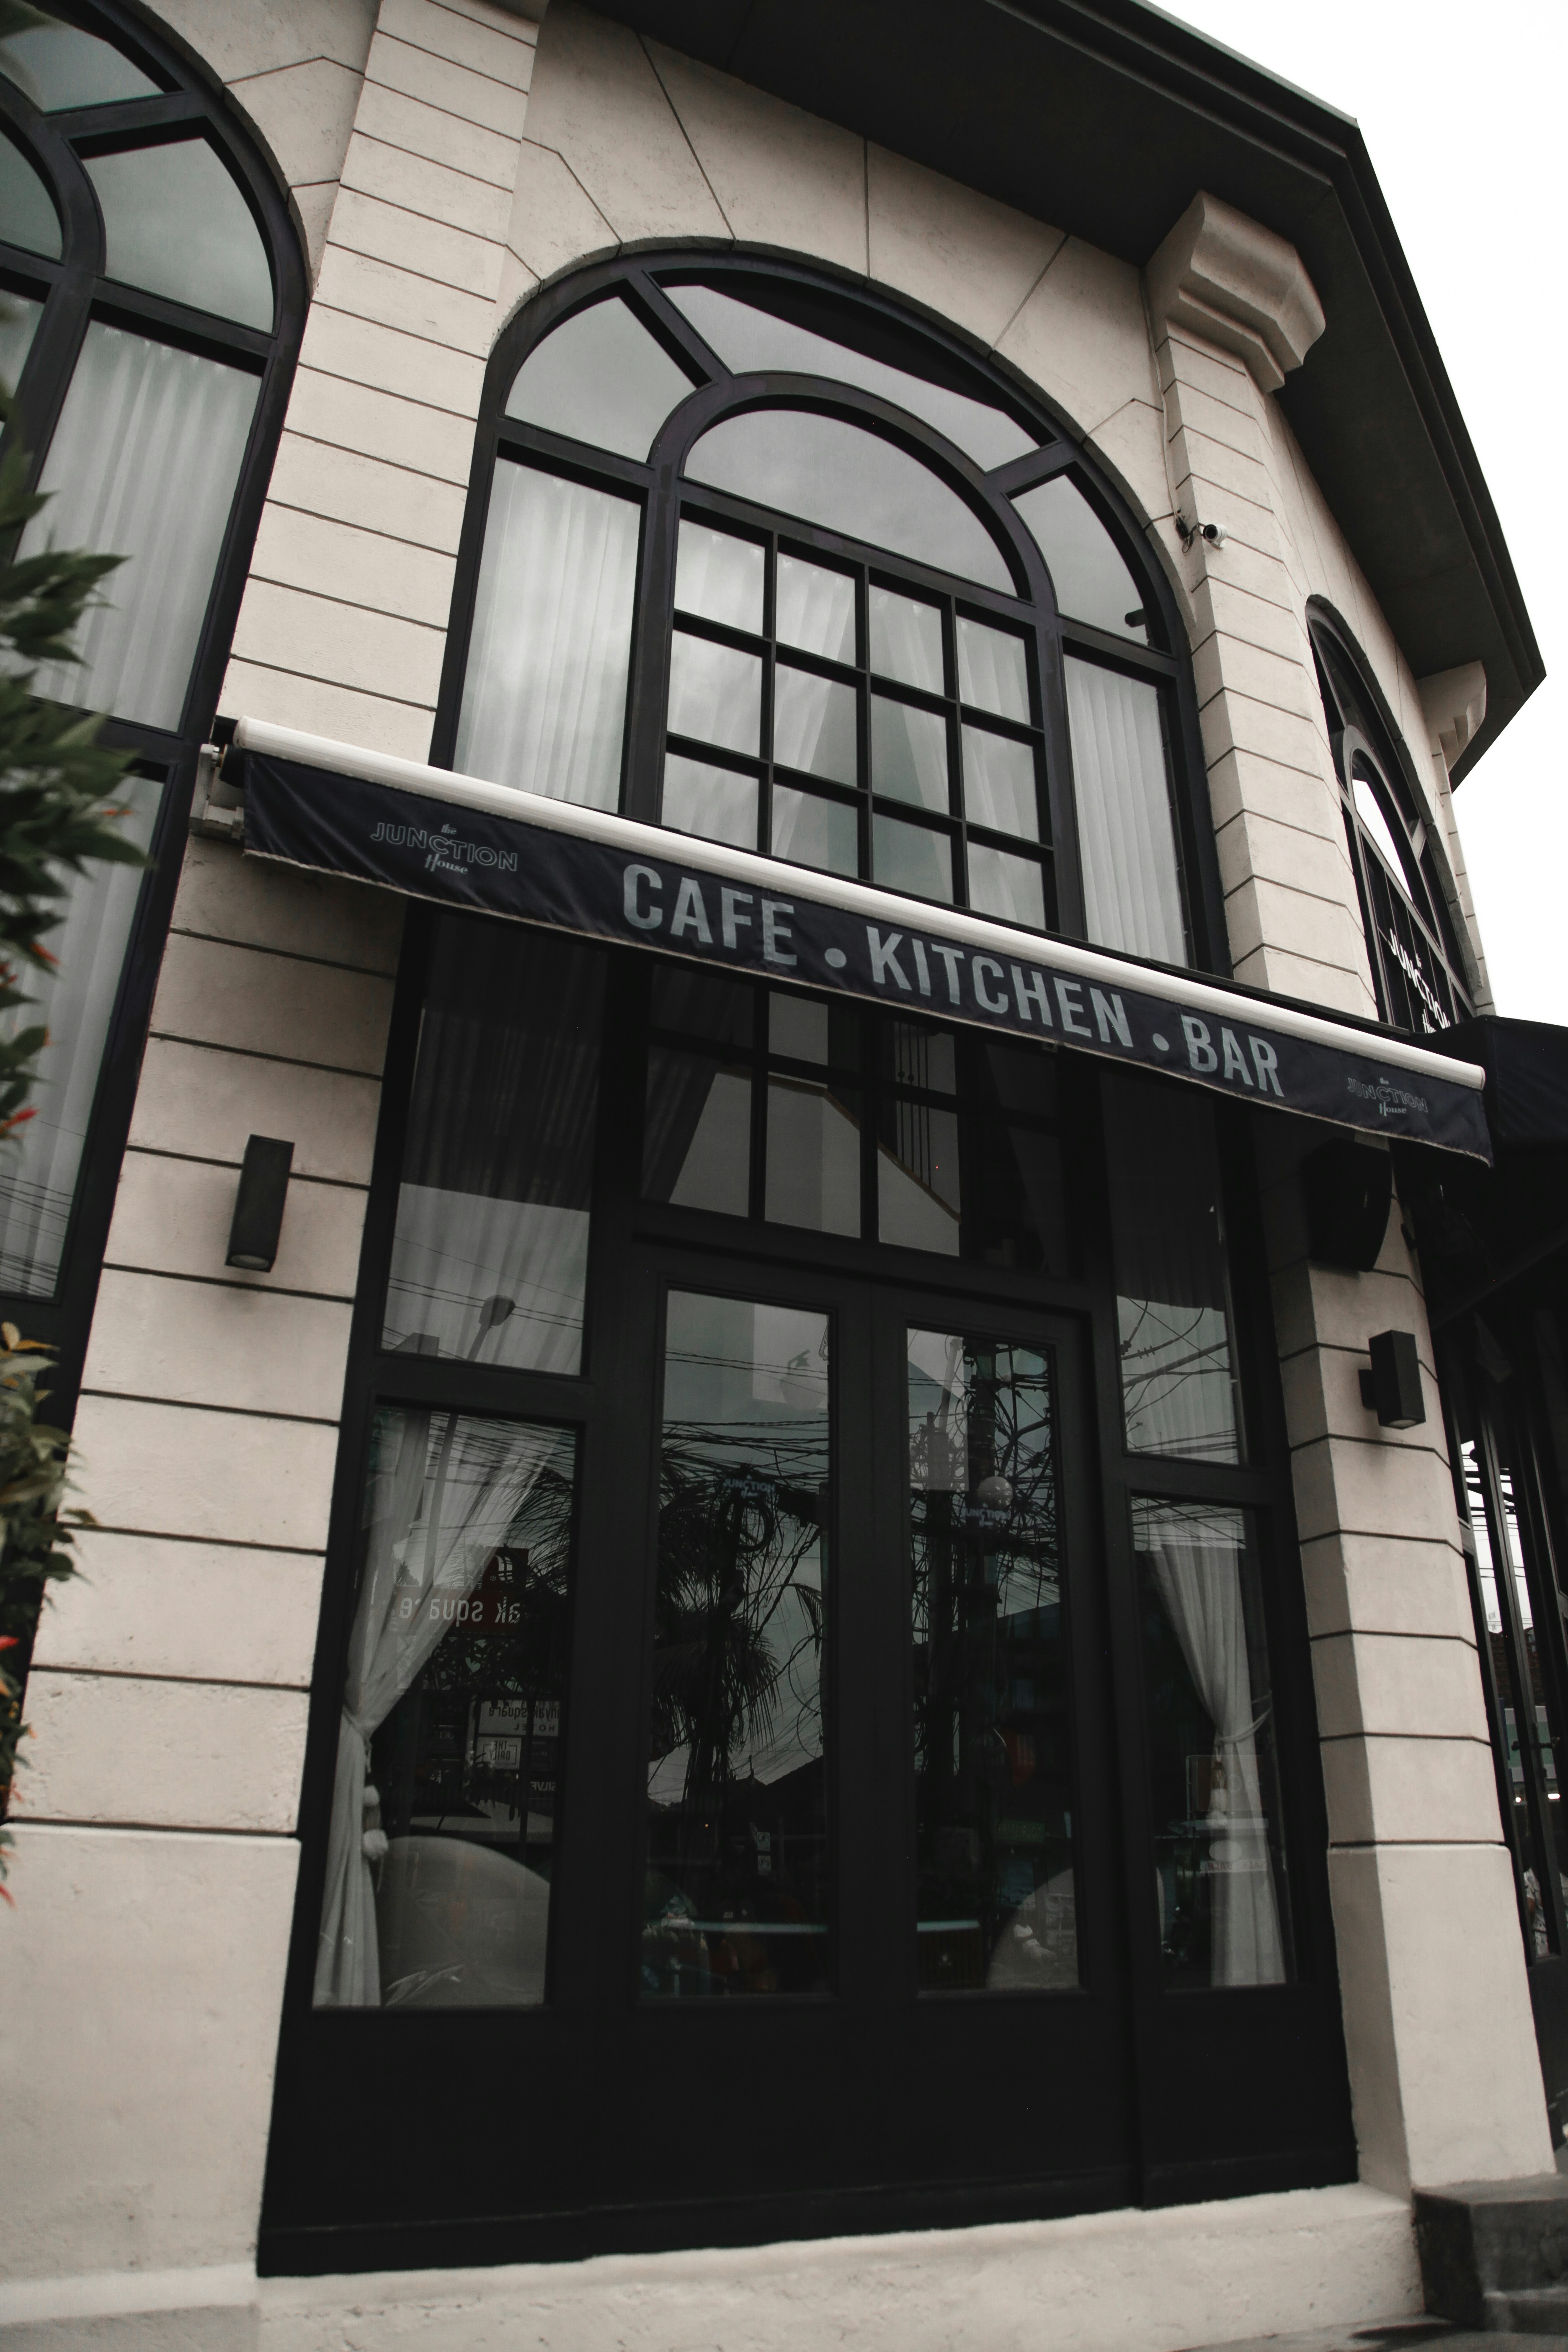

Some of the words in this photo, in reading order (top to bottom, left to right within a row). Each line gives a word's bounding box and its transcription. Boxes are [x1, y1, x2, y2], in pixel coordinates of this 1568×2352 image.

[441, 823, 457, 835] the
[370, 822, 518, 872] JUNCTION
[424, 853, 469, 874] House
[623, 863, 797, 966] CAFE
[866, 926, 1134, 1048] KITCHEN
[1180, 1014, 1285, 1097] BAR
[1347, 1077, 1428, 1113] JUNCTION
[1379, 1101, 1407, 1117] House
[722, 1478, 776, 1493] JUNCTION
